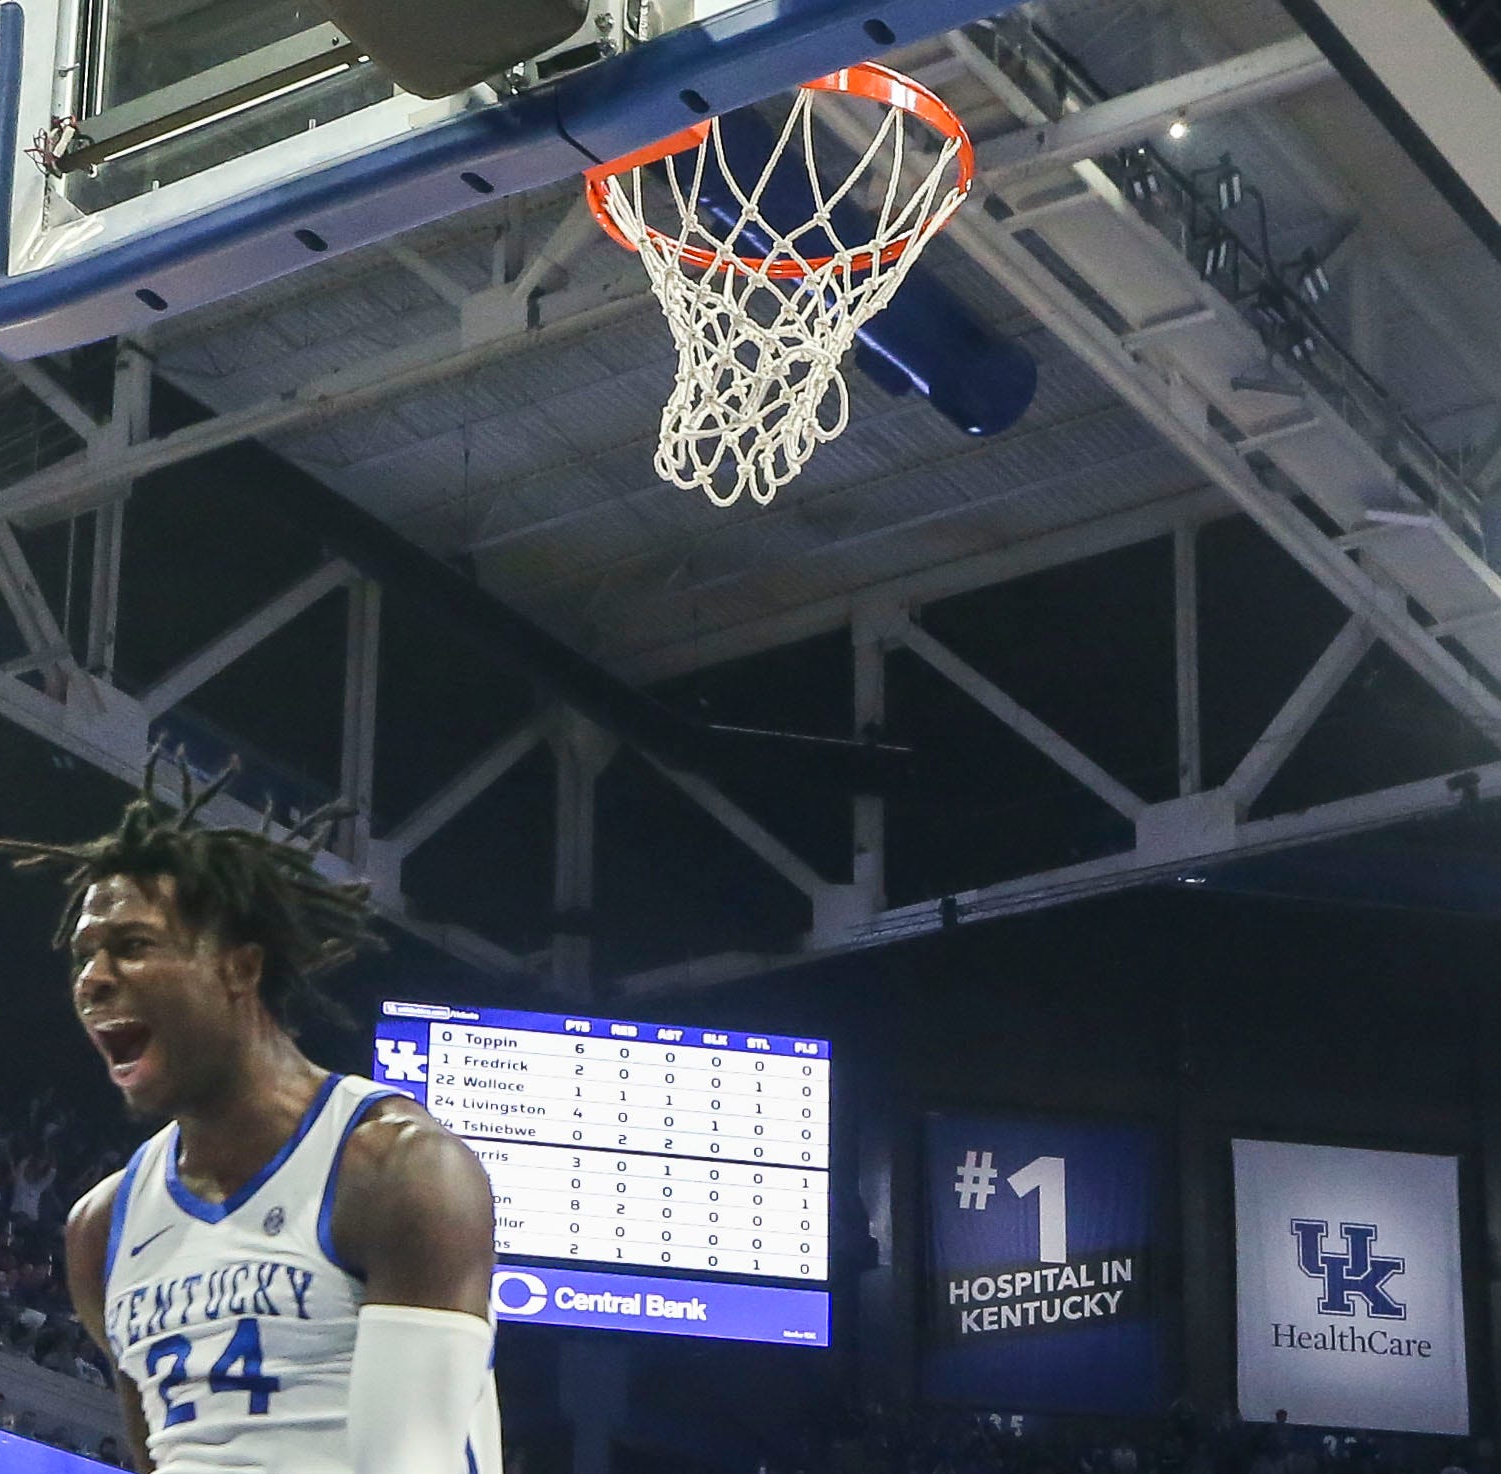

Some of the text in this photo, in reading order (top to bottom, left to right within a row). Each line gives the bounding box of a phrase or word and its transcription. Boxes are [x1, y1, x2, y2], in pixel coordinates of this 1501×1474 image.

[465, 1033, 518, 1049] Toppin
[575, 1043, 585, 1054] 6
[619, 1048, 630, 1059] 0
[665, 1052, 676, 1063] 0
[711, 1057, 722, 1068] 0
[755, 1061, 765, 1072] 0
[802, 1065, 812, 1076] 0
[564, 1019, 591, 1032] PTS
[657, 1028, 684, 1042] AST
[702, 1033, 729, 1046] BLK
[746, 1037, 771, 1050] STL
[435, 1074, 455, 1085] 22
[463, 1077, 524, 1092] Wallace
[710, 1099, 721, 1110] 0
[801, 1108, 811, 1119] 0
[464, 1055, 528, 1072] Fredrick
[575, 1064, 584, 1076] 2
[619, 1068, 629, 1080] 0
[664, 1073, 675, 1084] 0
[711, 1077, 721, 1089] 0
[802, 1086, 812, 1097] 0
[434, 1095, 454, 1107] 24
[462, 1098, 546, 1116] Livingston
[573, 1108, 583, 1118] 4
[618, 1112, 628, 1123] 0
[664, 1116, 674, 1127] 0
[754, 1125, 764, 1136] 0
[801, 1129, 812, 1140] 0
[462, 1119, 811, 1162] Tshiebwe 0 2 2 0 0 0
[571, 1157, 581, 1168] 3
[616, 1161, 627, 1172] 0
[709, 1169, 720, 1181] 0
[753, 1173, 763, 1184] 0
[955, 1151, 1067, 1263] #1
[949, 1258, 1132, 1304] HOSPITAL IN
[1290, 1218, 1406, 1321] UK
[554, 1286, 707, 1321] Central Bank
[960, 1290, 1123, 1334] KENTUCKY
[1271, 1323, 1432, 1358] HealthCare
[147, 1317, 280, 1429] 24
